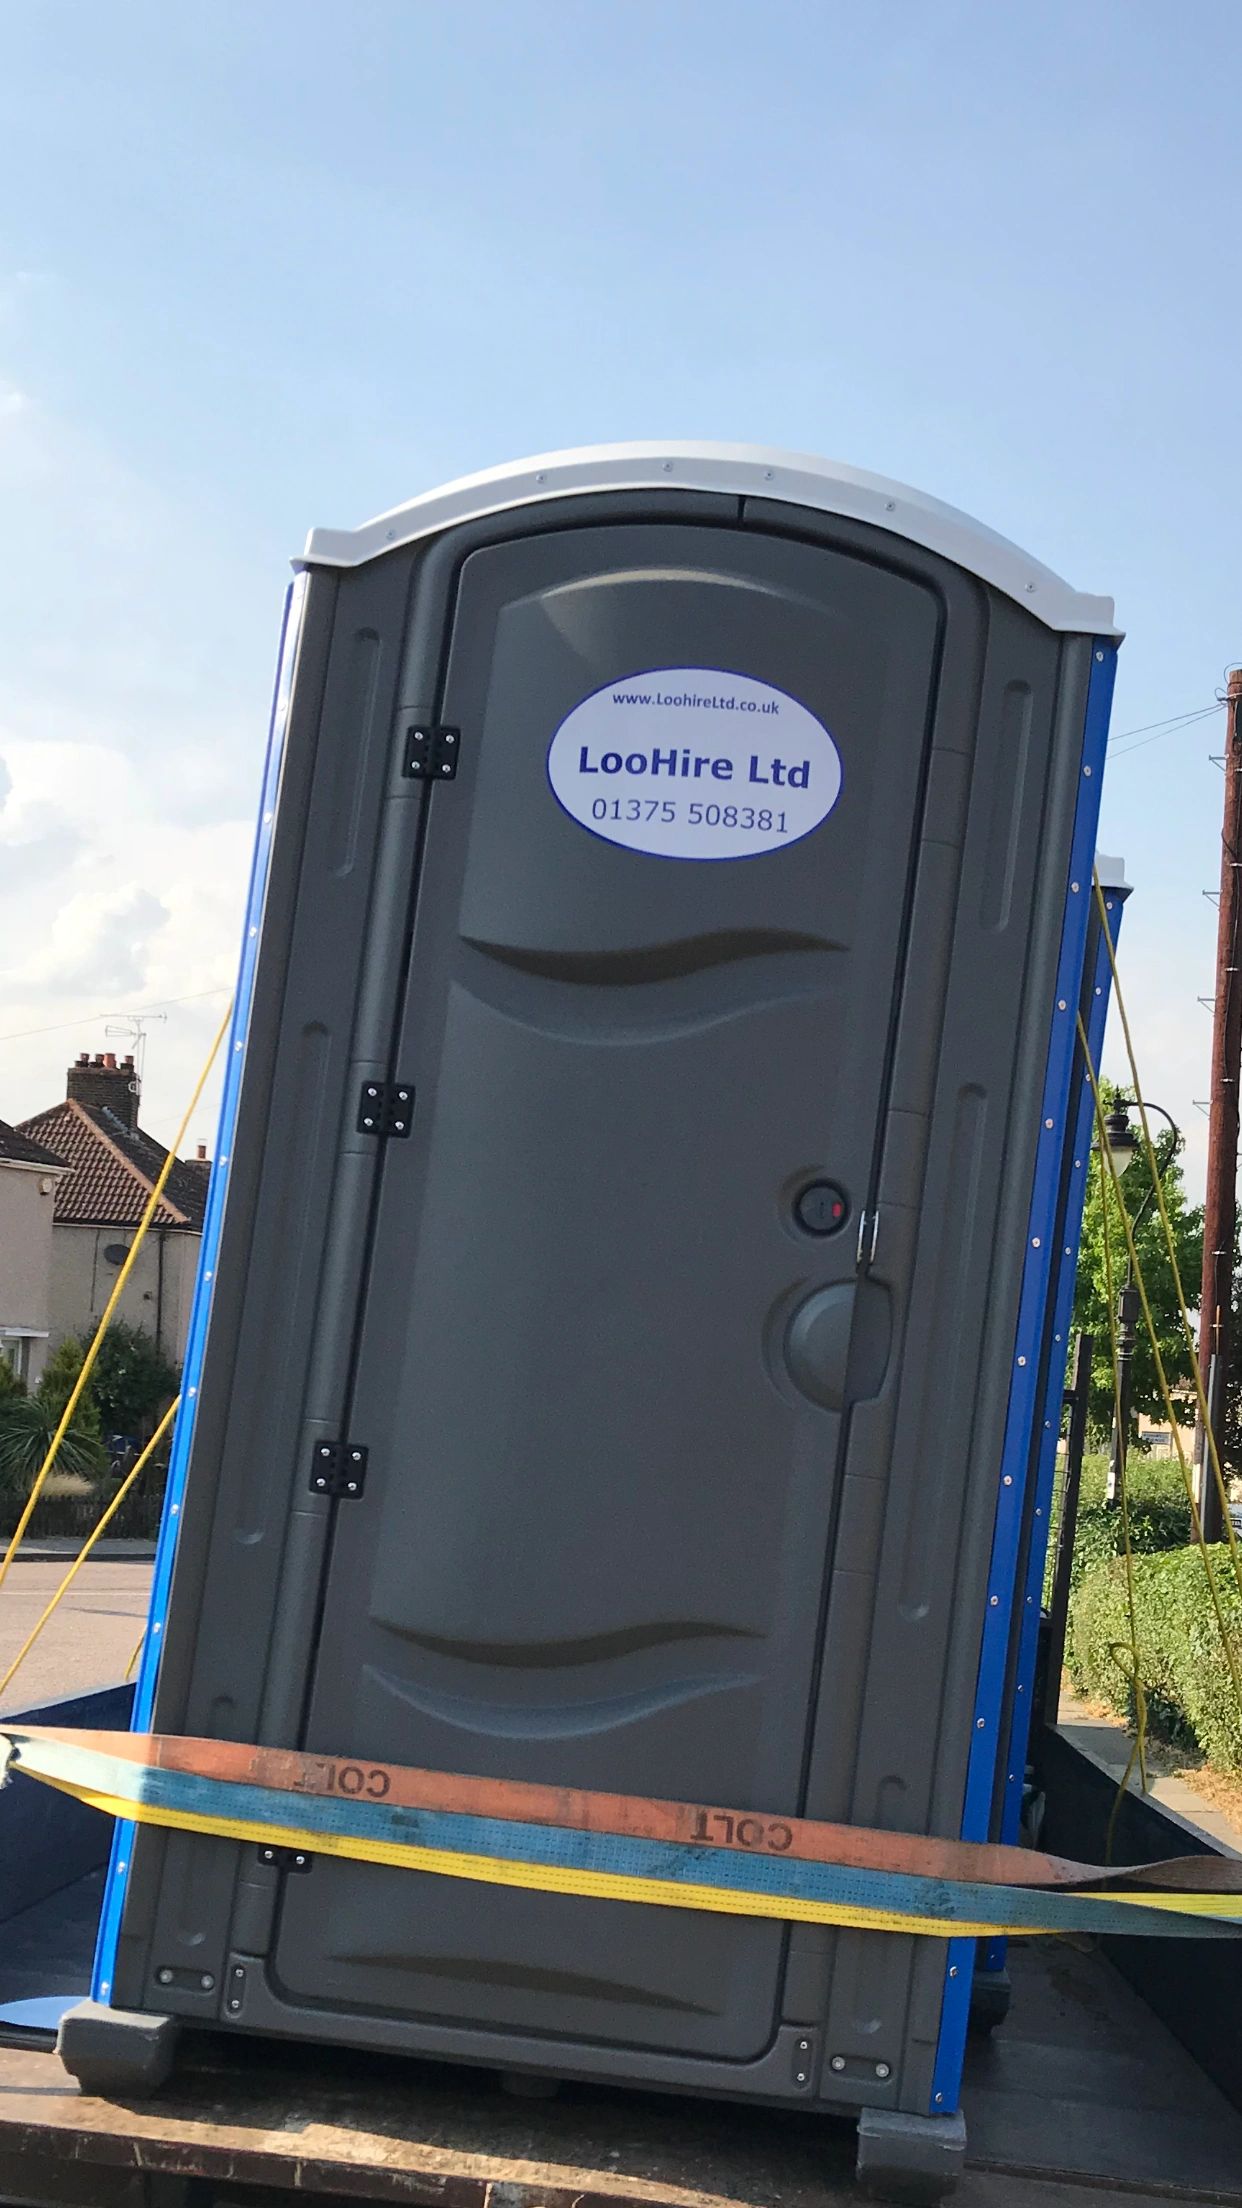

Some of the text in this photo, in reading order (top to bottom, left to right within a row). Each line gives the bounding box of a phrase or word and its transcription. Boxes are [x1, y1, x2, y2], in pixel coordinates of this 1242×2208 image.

[612, 692, 779, 714] www.LoohireLtd.co.uk
[578, 746, 811, 789] LooHire Ltd
[592, 798, 789, 833] 01375 508381
[690, 1810, 793, 1851] COLT
